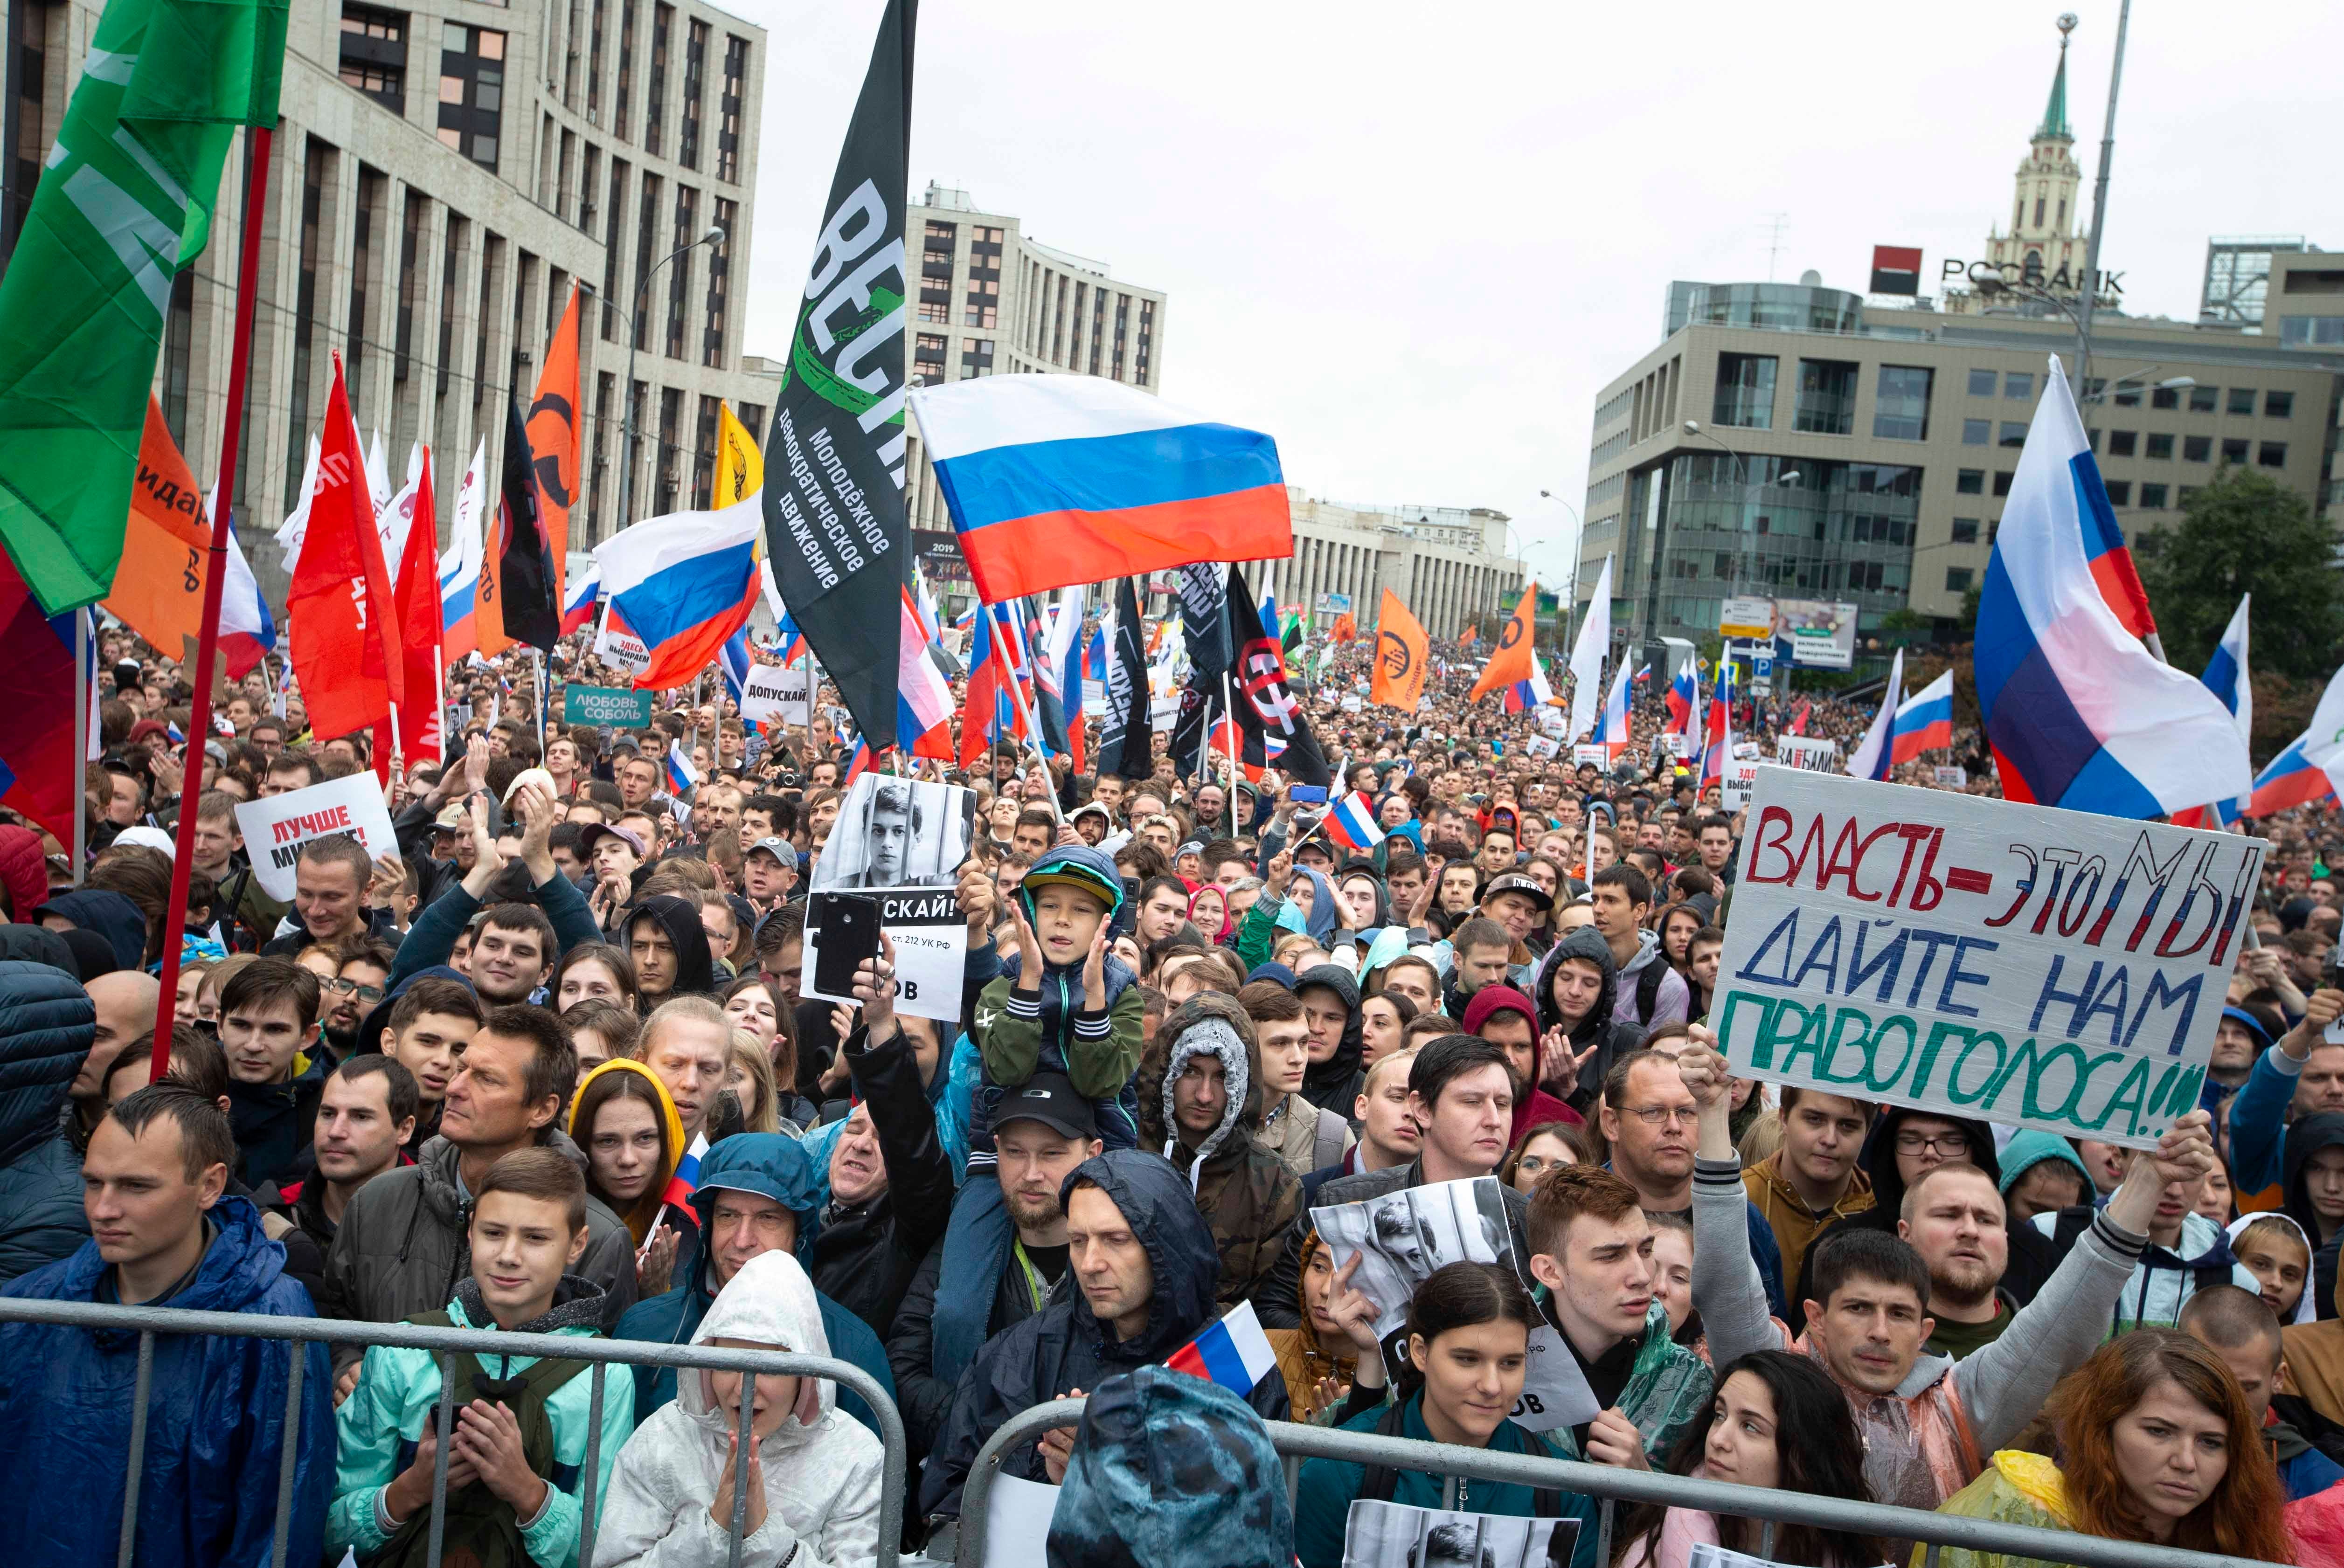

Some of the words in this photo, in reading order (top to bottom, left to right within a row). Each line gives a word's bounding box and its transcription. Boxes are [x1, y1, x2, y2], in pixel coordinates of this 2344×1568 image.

[779, 408, 864, 572] демократическое
[809, 427, 890, 555] Молодёжное
[779, 491, 839, 589] движение
[932, 543, 955, 553] 2019
[609, 645, 650, 663] ВЫБИРАЕМ
[619, 640, 643, 652] ЗДЕСЬ
[575, 694, 638, 708] ЛЮБОВЬ
[584, 707, 642, 720] СОБОЛЬ
[1738, 768, 1757, 781] ЗДЕ
[1727, 780, 1754, 790] ВЫБИ
[271, 805, 351, 844] ЛУЧШЕ
[883, 894, 955, 918] СКАЙ!
[905, 936, 919, 945] 212
[922, 938, 934, 947] УК
[936, 941, 950, 950] РФ
[1735, 907, 1999, 1018] ДАЙТЕ
[2028, 954, 2204, 1057] НАМ
